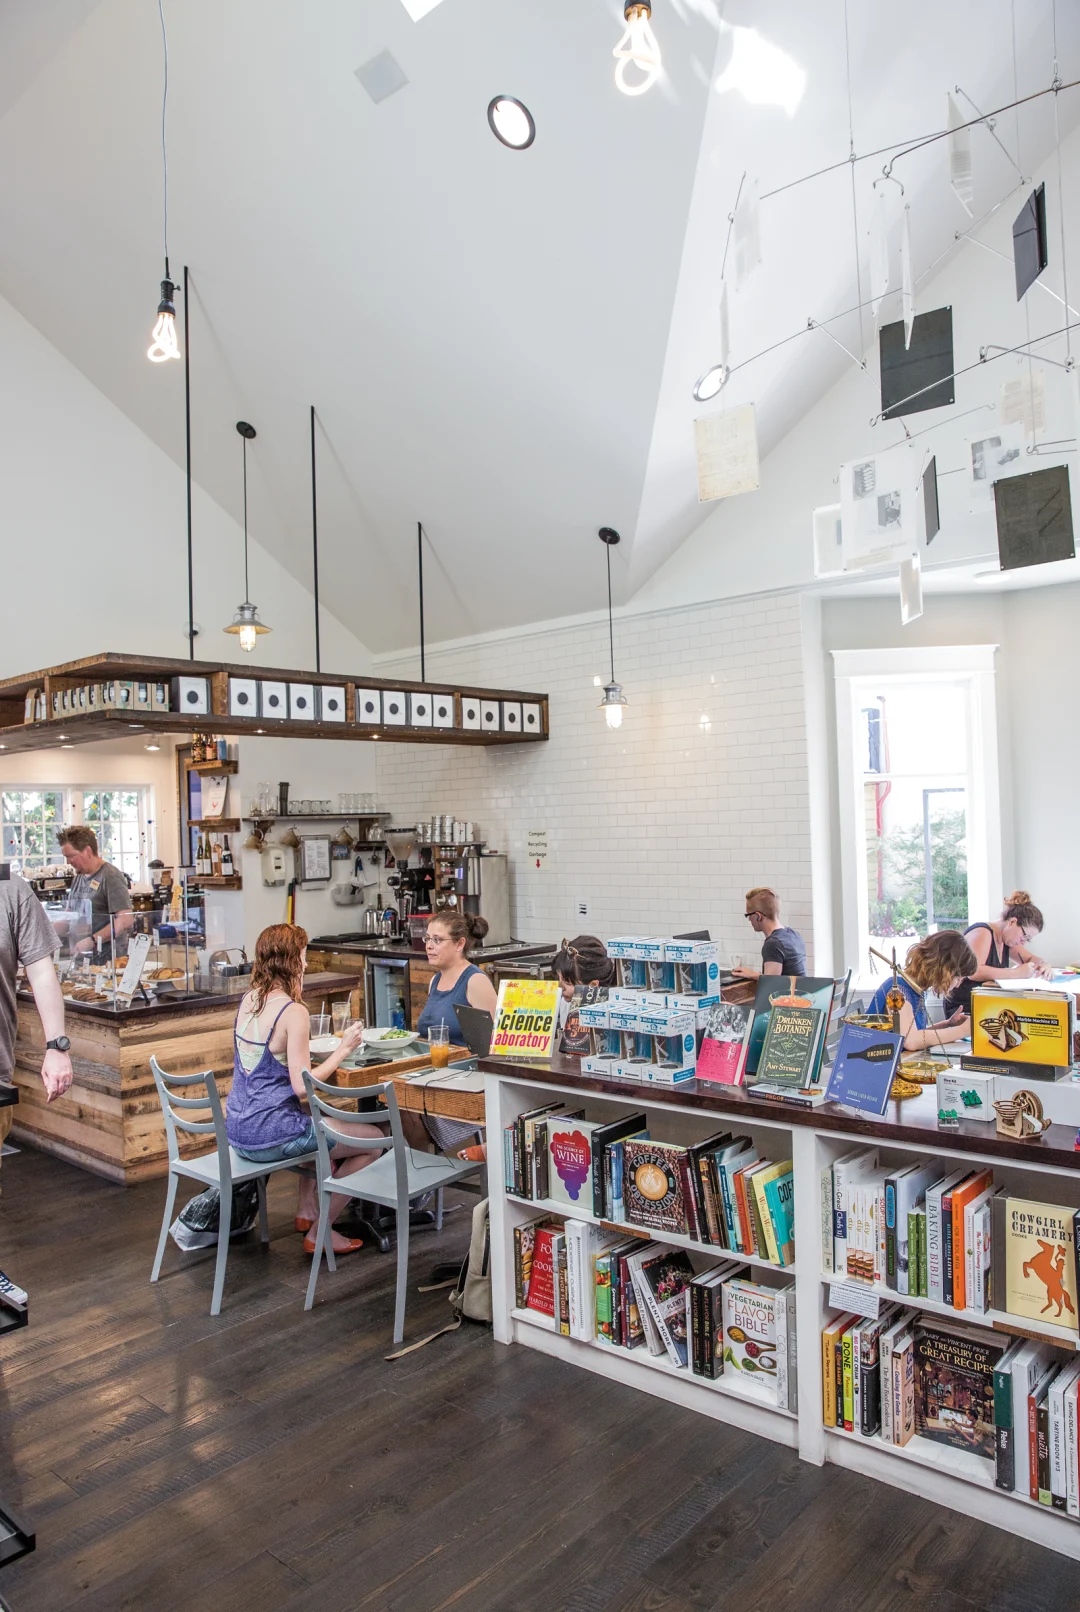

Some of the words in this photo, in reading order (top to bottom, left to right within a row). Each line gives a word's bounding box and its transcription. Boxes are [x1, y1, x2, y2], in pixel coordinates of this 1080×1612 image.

[495, 1008, 553, 1032] Science
[773, 1023, 812, 1037] BOTANIST
[776, 1015, 813, 1026] DRUNKEN
[490, 1029, 551, 1052] Laboratory
[867, 1048, 892, 1058] UNCORKED
[766, 1062, 779, 1071] AMY
[778, 1064, 801, 1073] STEWART
[765, 1093, 785, 1101] PROOF
[556, 1149, 585, 1165] WINE
[563, 1145, 578, 1153] SCIENCE
[633, 1154, 670, 1173] COFFEE
[630, 1184, 675, 1211] OBSESSION
[747, 1199, 756, 1228] BOTTLE
[836, 1211, 844, 1229] Chefs
[1011, 1210, 1065, 1230] COWGIRL
[928, 1204, 938, 1250] BAKING
[1011, 1221, 1074, 1243] CREAMERY
[1011, 1232, 1028, 1240] COOKS
[533, 1260, 554, 1273] COOK
[929, 1252, 939, 1288] BIBLE
[528, 1296, 549, 1308] HAROLD
[634, 1288, 648, 1332] OTTOLENGHI
[666, 1297, 685, 1310] PLENTY
[727, 1299, 775, 1325] FLAVOR
[729, 1293, 774, 1312] VEGETARIAN
[647, 1296, 662, 1324] PLENTY
[660, 1325, 672, 1347] MORE
[734, 1313, 768, 1336] BIBLE
[923, 1332, 939, 1342] MARY
[947, 1338, 972, 1350] VINCENT
[972, 1346, 990, 1356] PRICE
[934, 1340, 973, 1357] TREASURY
[974, 1353, 987, 1362] OF
[919, 1345, 952, 1361] GREAT
[954, 1355, 995, 1375] RECIPES
[740, 1369, 754, 1379] KAREN
[754, 1373, 765, 1382] PAGE
[1038, 1431, 1048, 1460] miette
